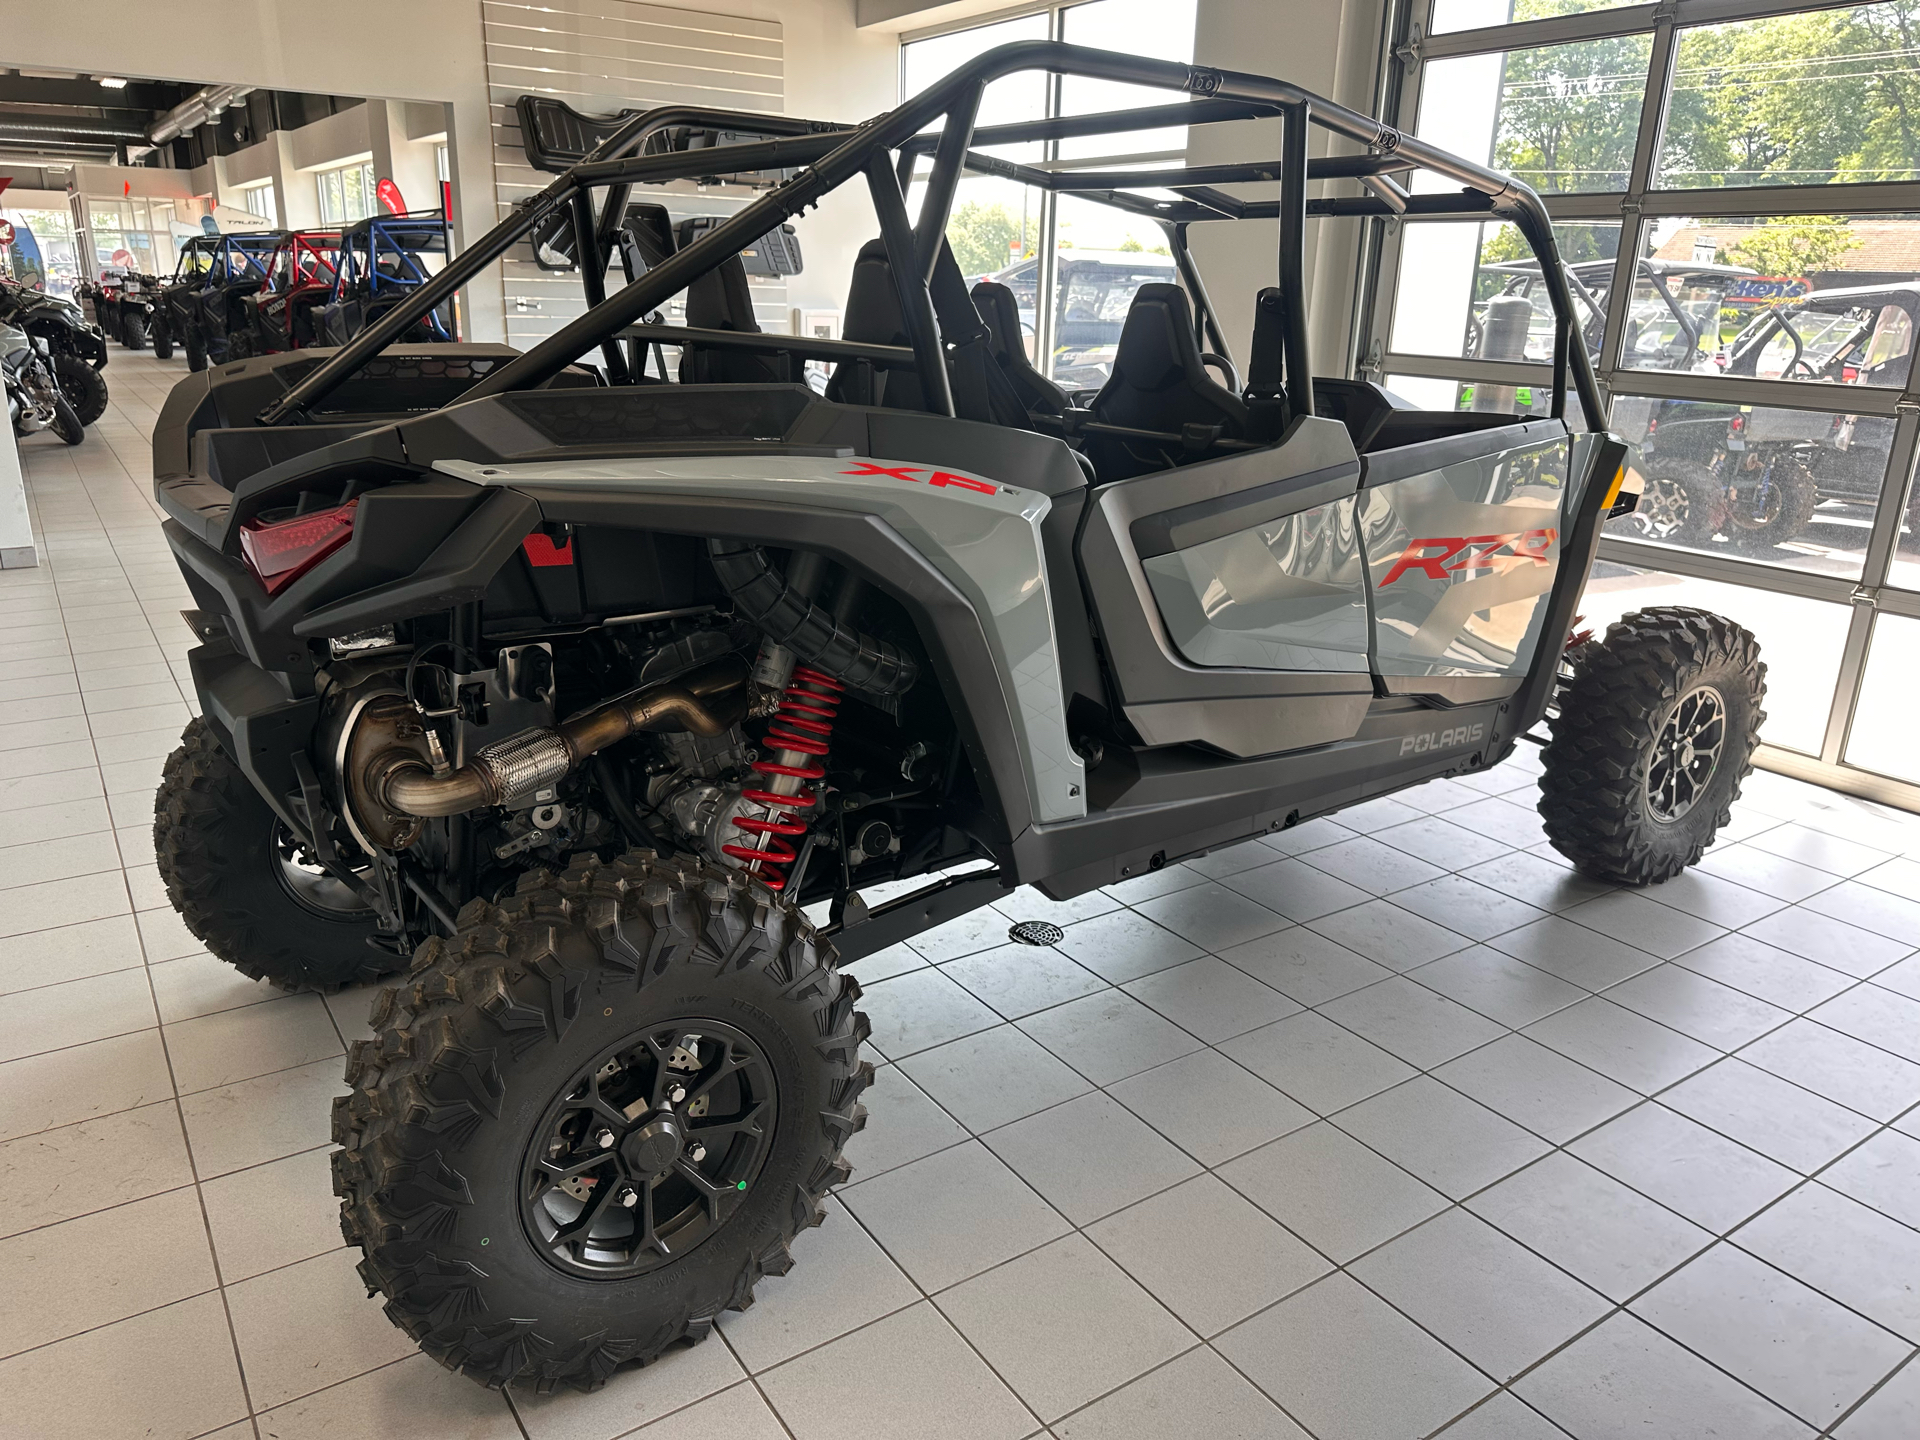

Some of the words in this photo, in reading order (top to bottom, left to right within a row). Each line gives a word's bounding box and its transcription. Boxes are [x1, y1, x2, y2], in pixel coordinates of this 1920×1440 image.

[266, 298, 287, 316] HONDA
[1377, 527, 1559, 589] RZR
[1399, 723, 1484, 756] POLARIS
